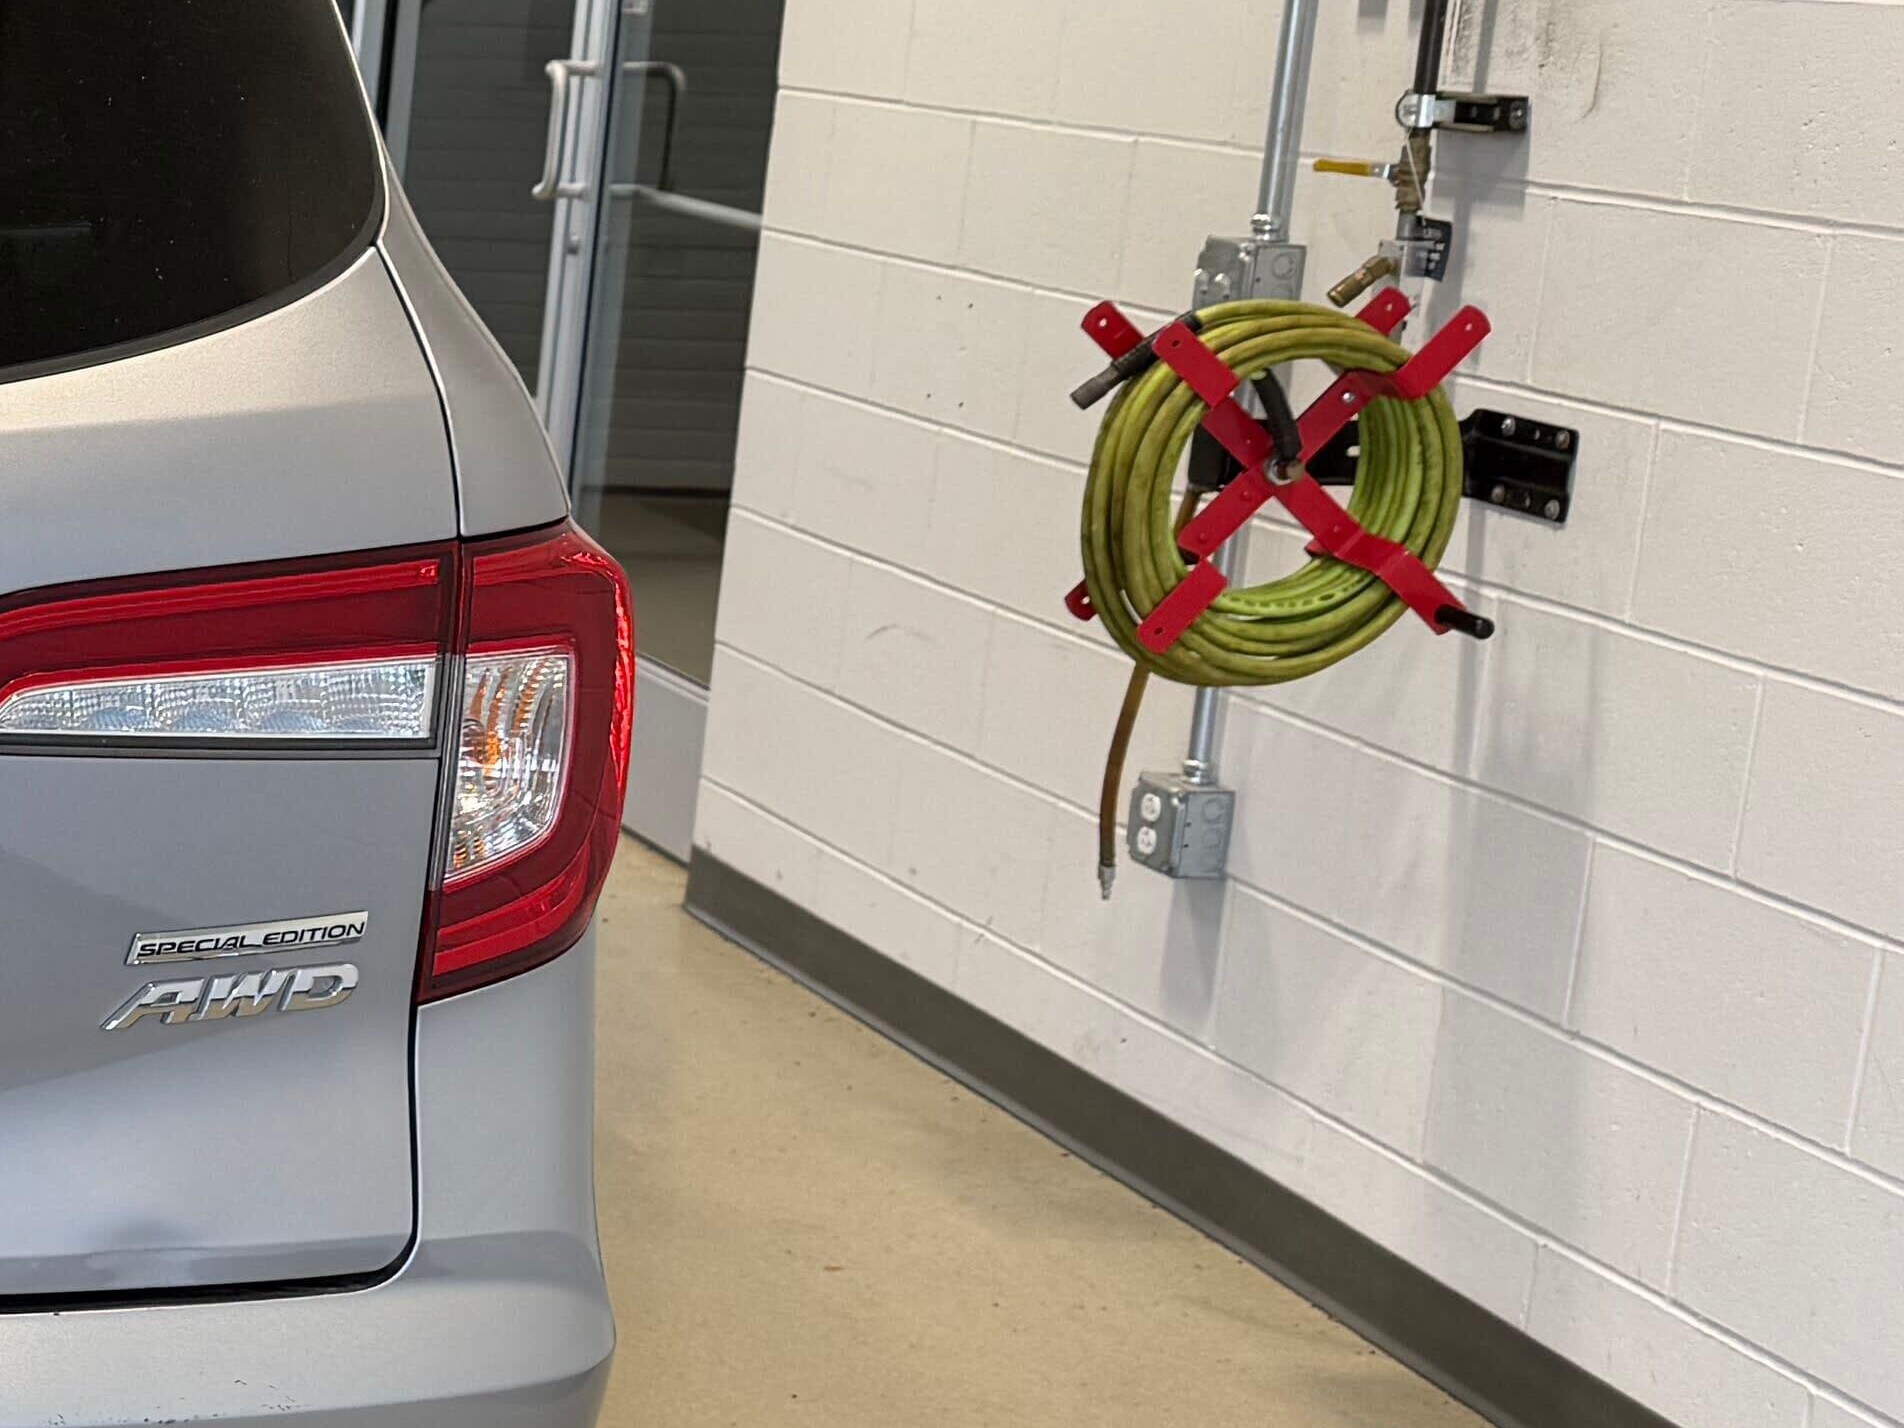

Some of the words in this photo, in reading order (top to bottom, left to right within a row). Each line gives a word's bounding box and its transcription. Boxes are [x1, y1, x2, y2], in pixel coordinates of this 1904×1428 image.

[137, 935, 258, 958] SPECIAL
[262, 922, 366, 947] EDITION
[100, 963, 360, 1030] AWD
